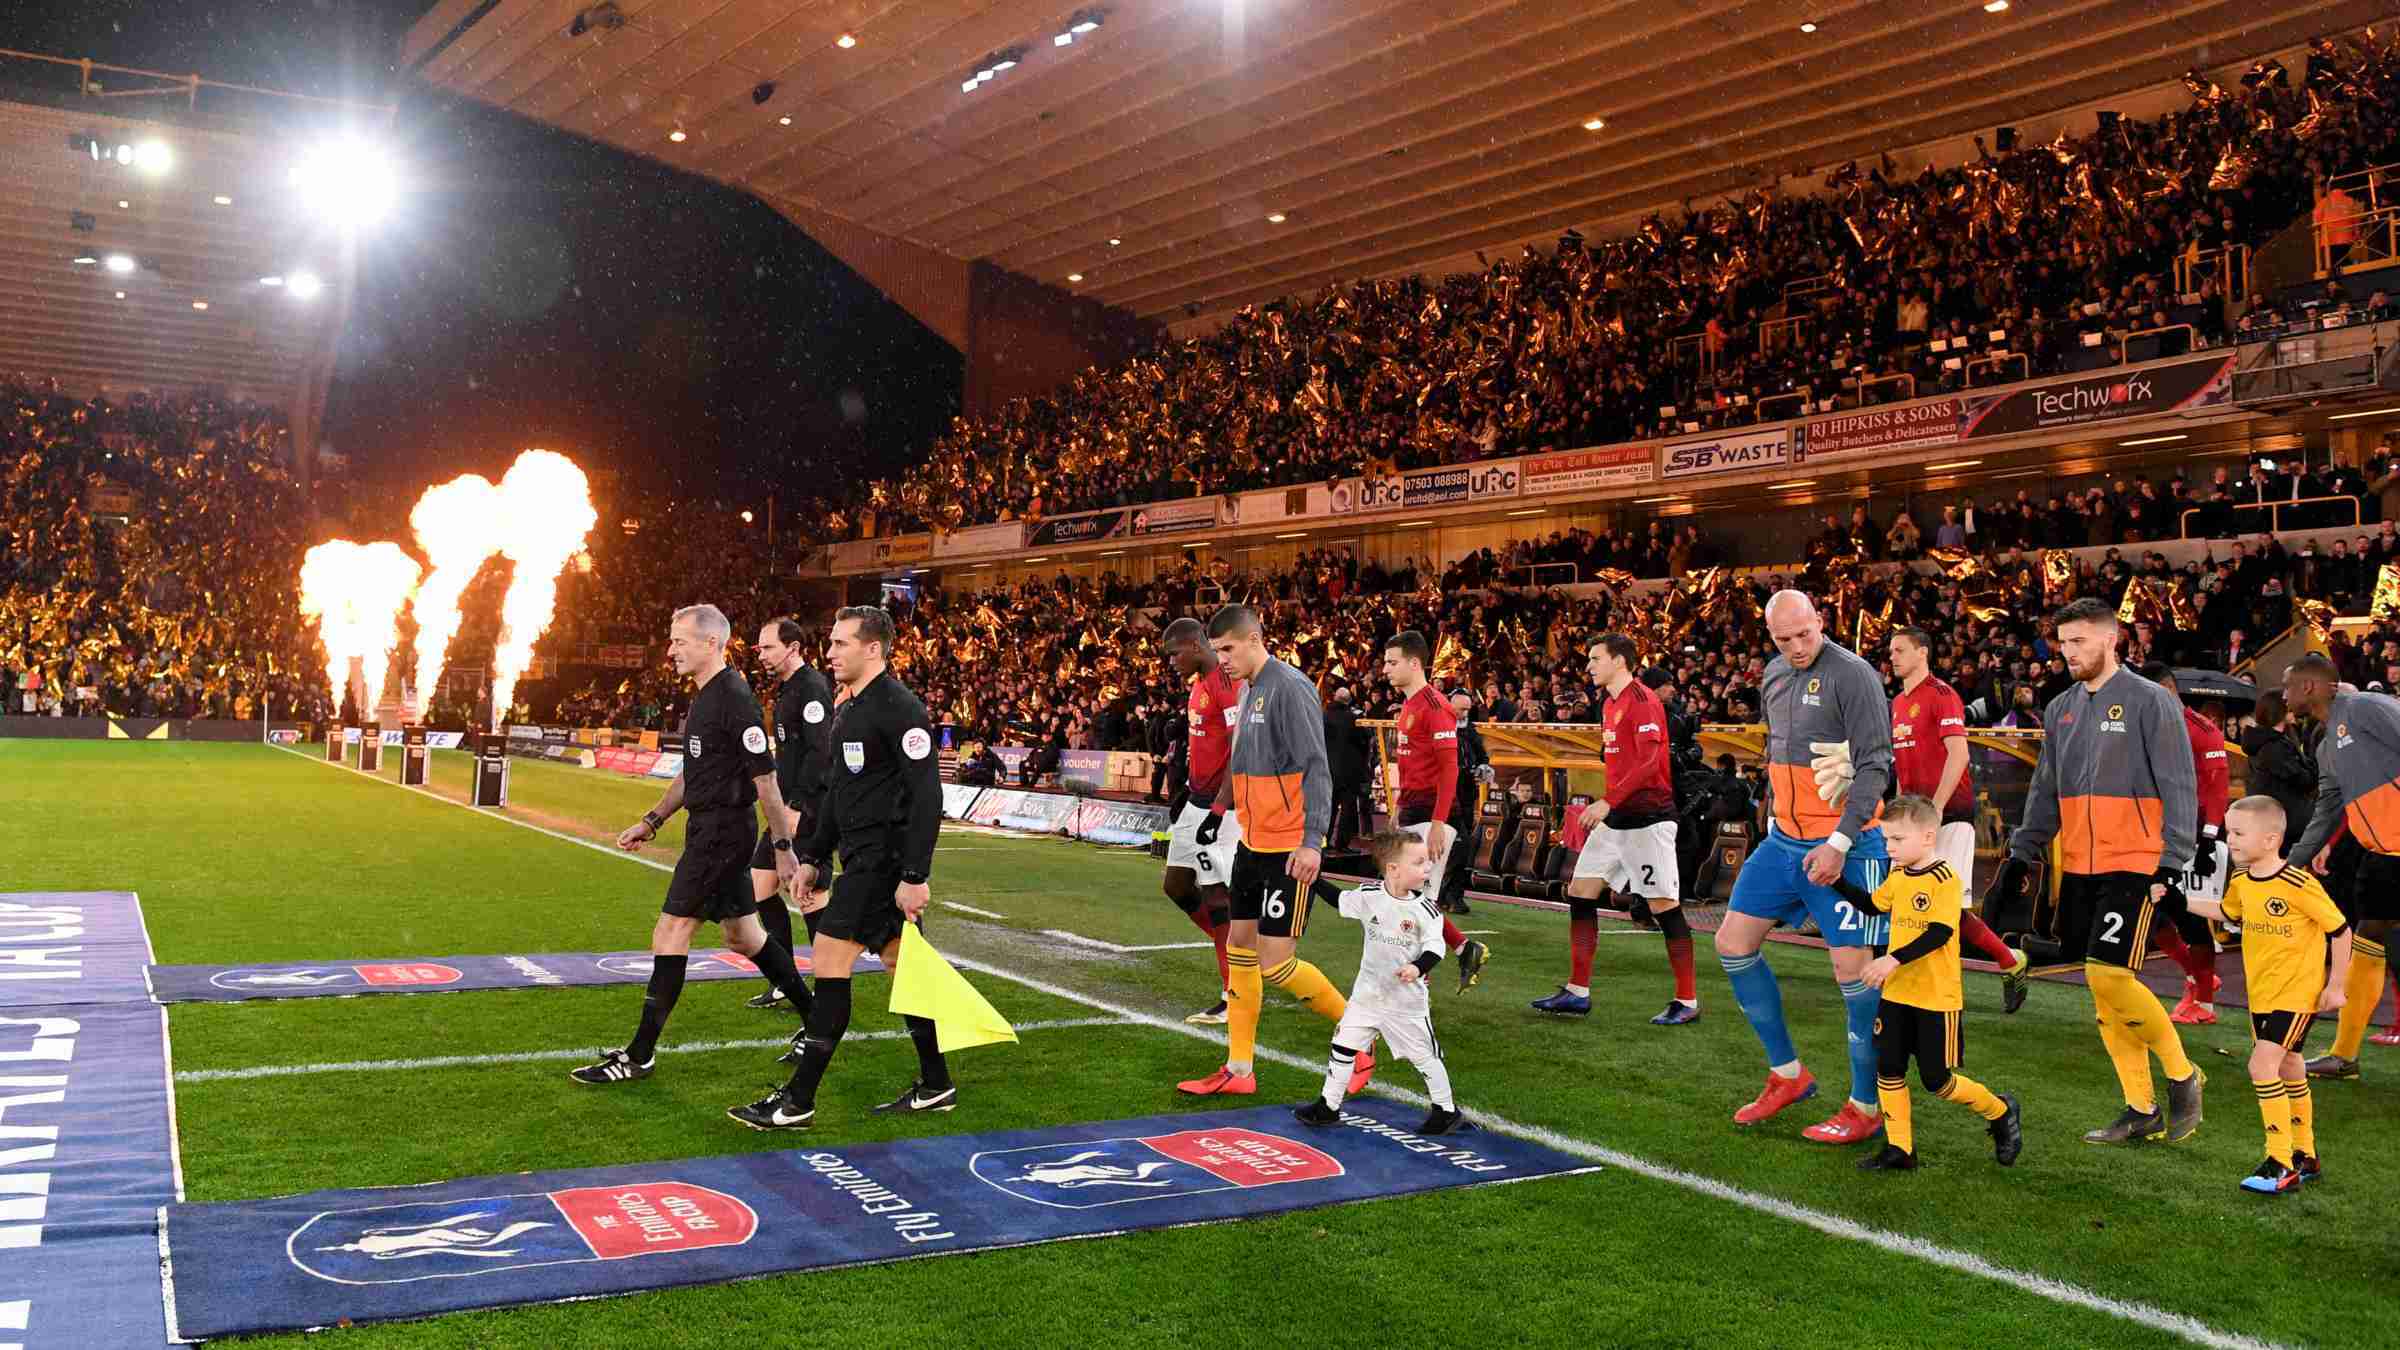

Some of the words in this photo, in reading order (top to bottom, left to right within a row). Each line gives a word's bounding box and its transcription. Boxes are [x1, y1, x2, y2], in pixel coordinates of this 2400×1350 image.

[2032, 380, 2152, 415] Techworx
[1812, 423, 1827, 437] RJ
[1831, 413, 1890, 434] HIPKISS
[1895, 411, 1906, 424] &
[1909, 403, 1951, 422] SONS
[1808, 438, 1840, 452] Quality
[1842, 432, 1883, 447] Butchers
[1885, 430, 1893, 439] &
[1896, 424, 1956, 438] Delicatessen
[1718, 442, 1786, 464] WASTE
[1361, 482, 1400, 505] URC
[1405, 476, 1432, 491] 07503
[1472, 471, 1516, 493] URC
[1063, 758, 1102, 769] voucher
[1196, 852, 1212, 871] 6
[1641, 864, 1655, 886] 2
[1262, 889, 1286, 918] 16
[1834, 900, 1864, 930] 21
[2099, 911, 2124, 943] 2
[1337, 1111, 1447, 1153] Emirat
[1434, 1150, 1507, 1172] Fly
[800, 1153, 914, 1215] Emirates
[611, 1191, 684, 1243] Emirates
[660, 1195, 696, 1220] CUP
[683, 1213, 720, 1231] FA
[887, 1212, 956, 1243] Fly
